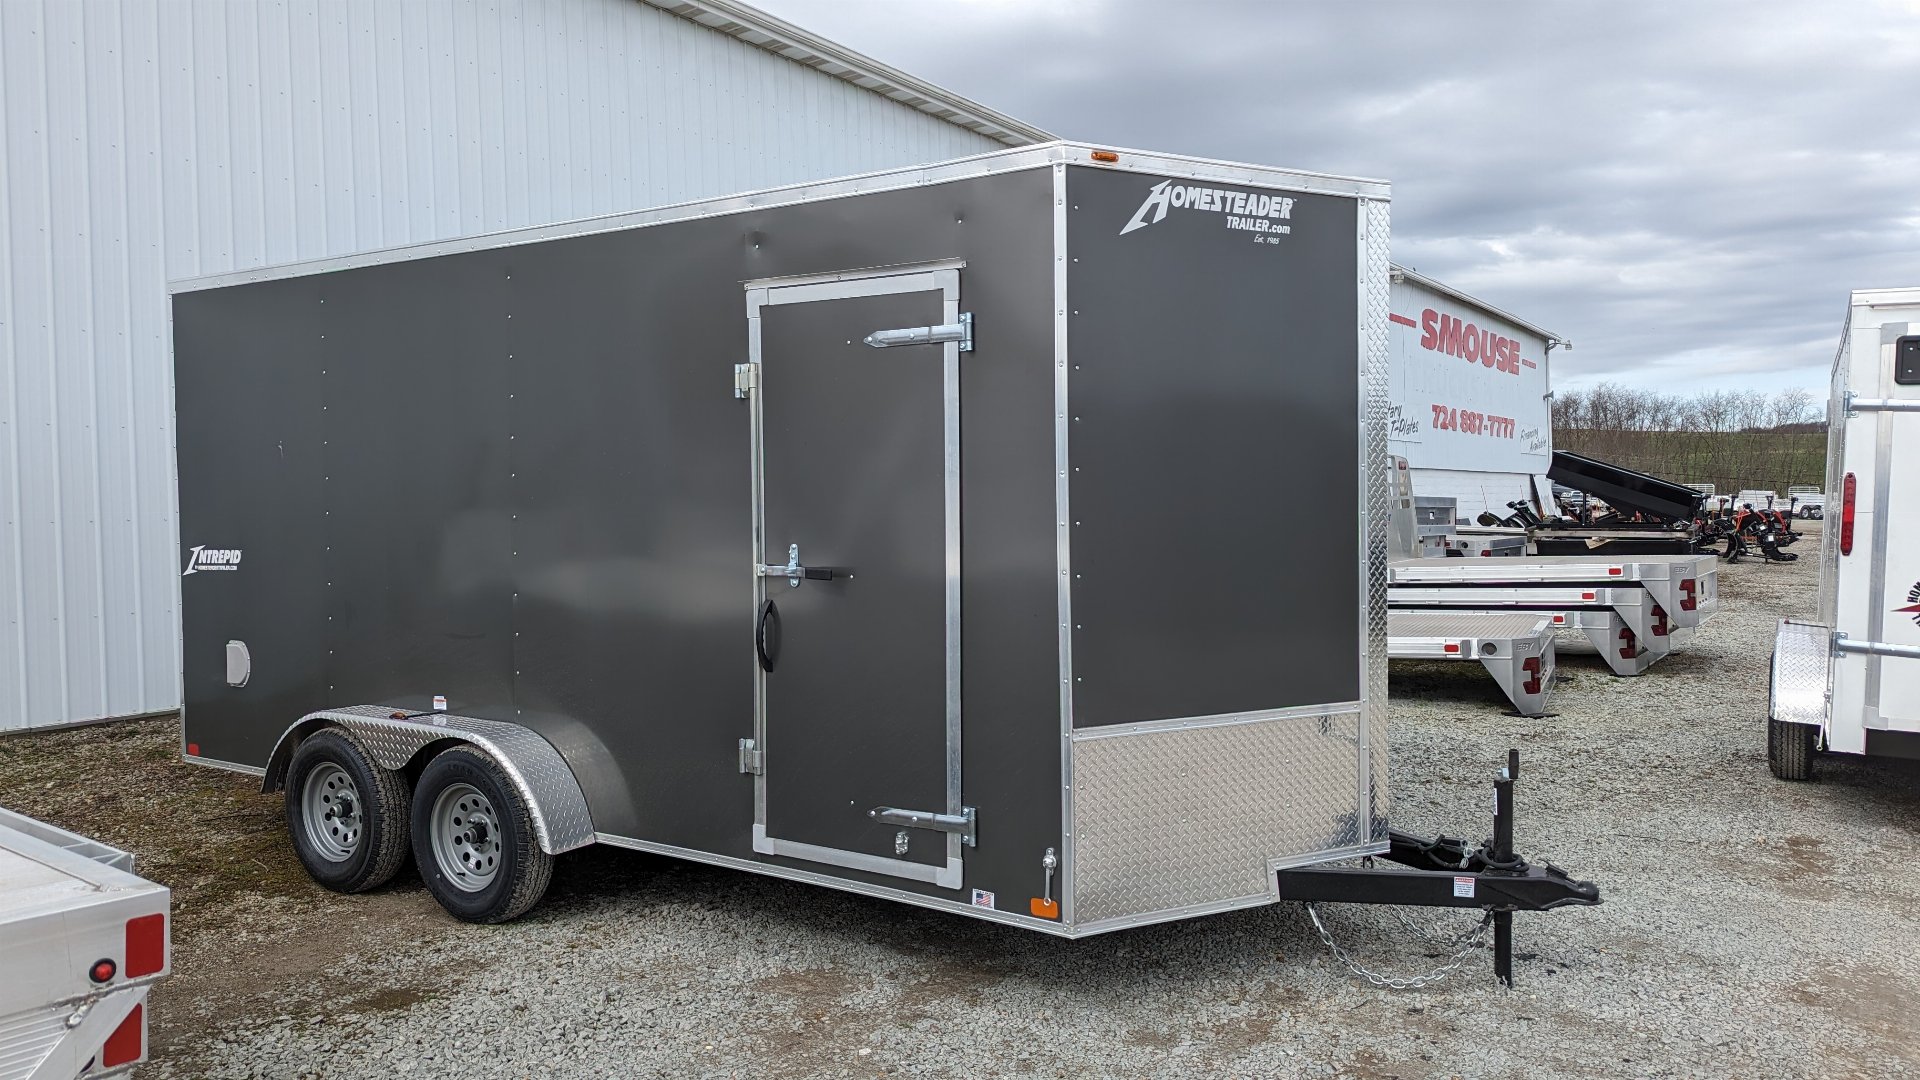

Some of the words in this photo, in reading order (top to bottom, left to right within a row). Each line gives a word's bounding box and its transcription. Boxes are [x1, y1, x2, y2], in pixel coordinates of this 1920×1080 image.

[1119, 179, 1294, 235] HOMESTEADER
[1226, 215, 1291, 235] TRAILER.com
[1420, 308, 1521, 376] SMOUSE
[1431, 404, 1458, 432] 724
[1460, 409, 1516, 440] 887-7777
[182, 544, 242, 576] INTREPID
